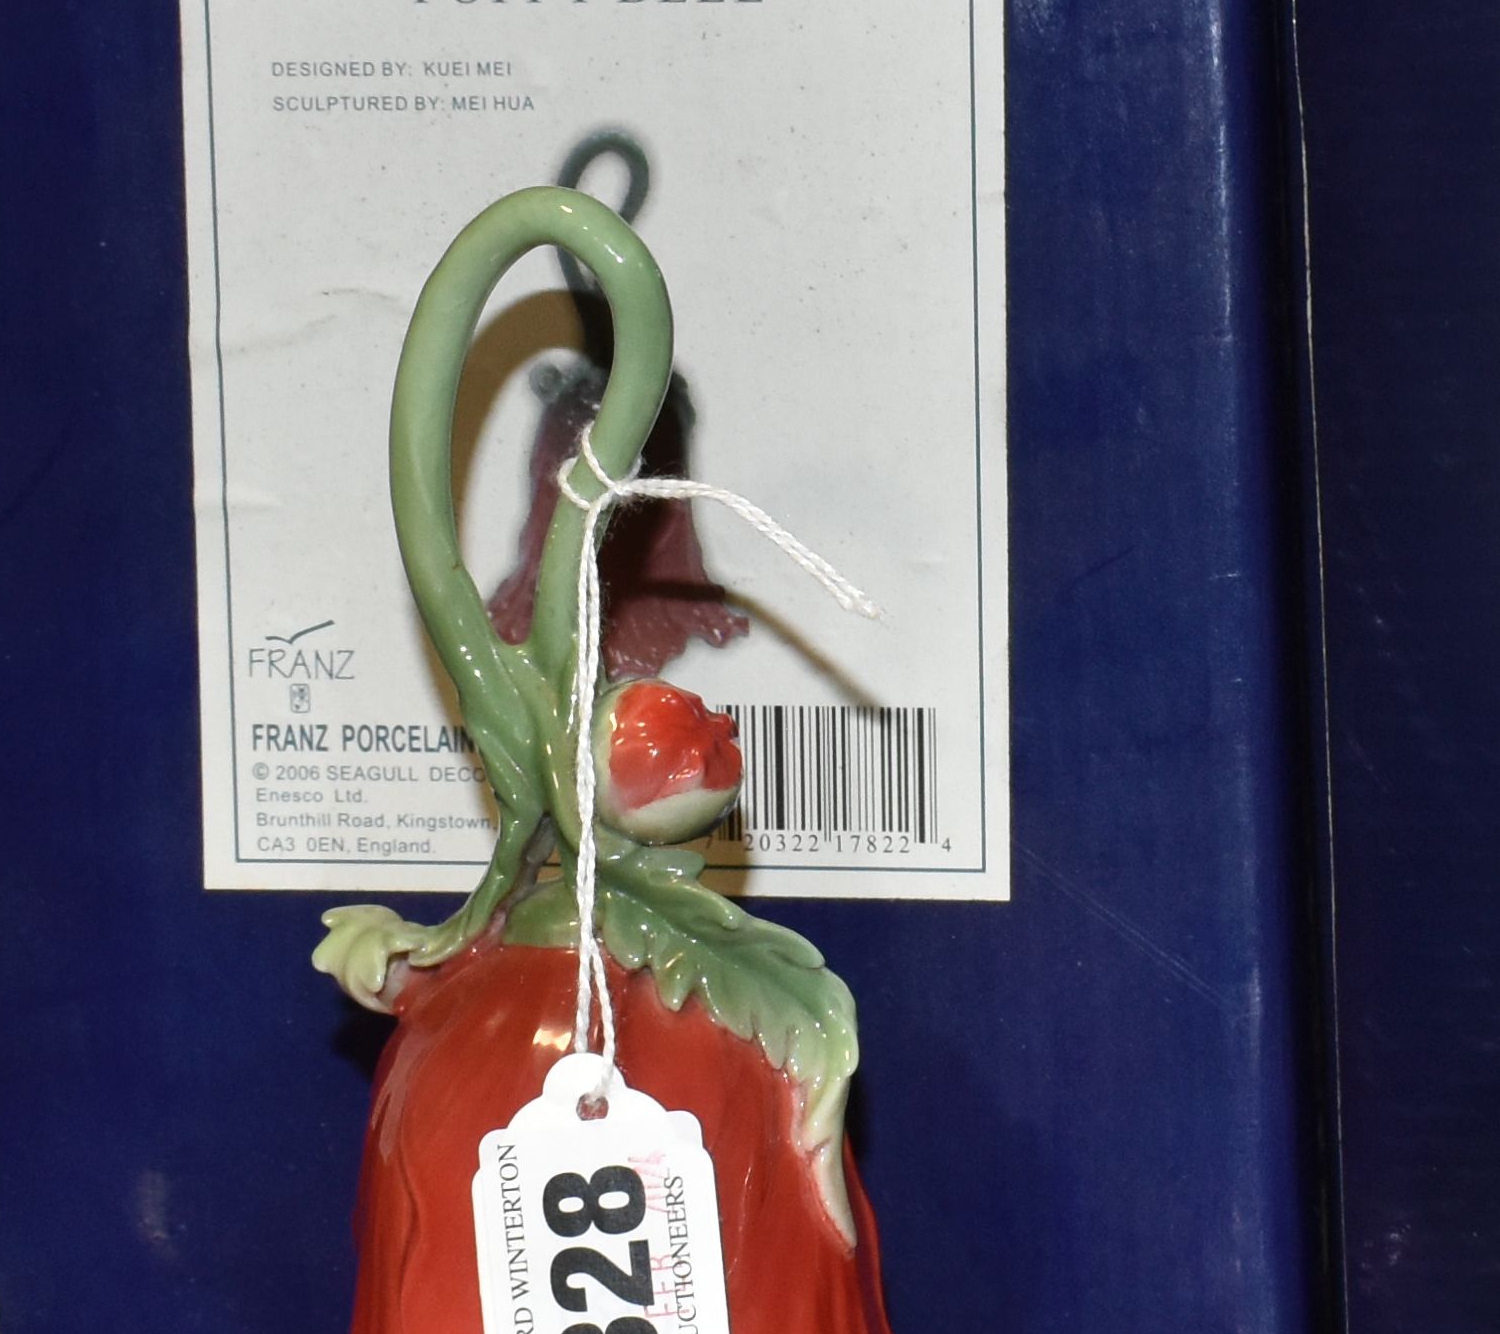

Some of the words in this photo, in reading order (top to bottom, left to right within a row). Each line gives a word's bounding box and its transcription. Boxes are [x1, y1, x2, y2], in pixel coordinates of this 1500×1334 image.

[272, 62, 375, 77] DESIGNED
[382, 62, 413, 77] BY:
[423, 62, 470, 76] KUEI
[477, 61, 512, 76] MEI
[272, 96, 408, 111] SCULPTURED
[414, 96, 445, 111] BY:
[452, 96, 487, 111] MEI
[493, 96, 535, 111] HUA
[249, 648, 355, 680] FRANZ
[252, 724, 328, 752] FRANZ
[342, 724, 477, 753] PORCELAIN
[276, 765, 320, 781] 2006
[326, 765, 419, 782] SEAGULL
[256, 788, 324, 803] Enesco
[334, 788, 369, 803] Ltd.
[256, 813, 332, 828] Brunthill
[338, 814, 391, 831] Road,
[397, 814, 498, 835] Kingstown,
[257, 837, 296, 852] CA3
[357, 837, 436, 857] England.
[744, 833, 819, 853] 20322
[836, 834, 910, 854] 17822
[497, 1144, 530, 1301] WINTERTON
